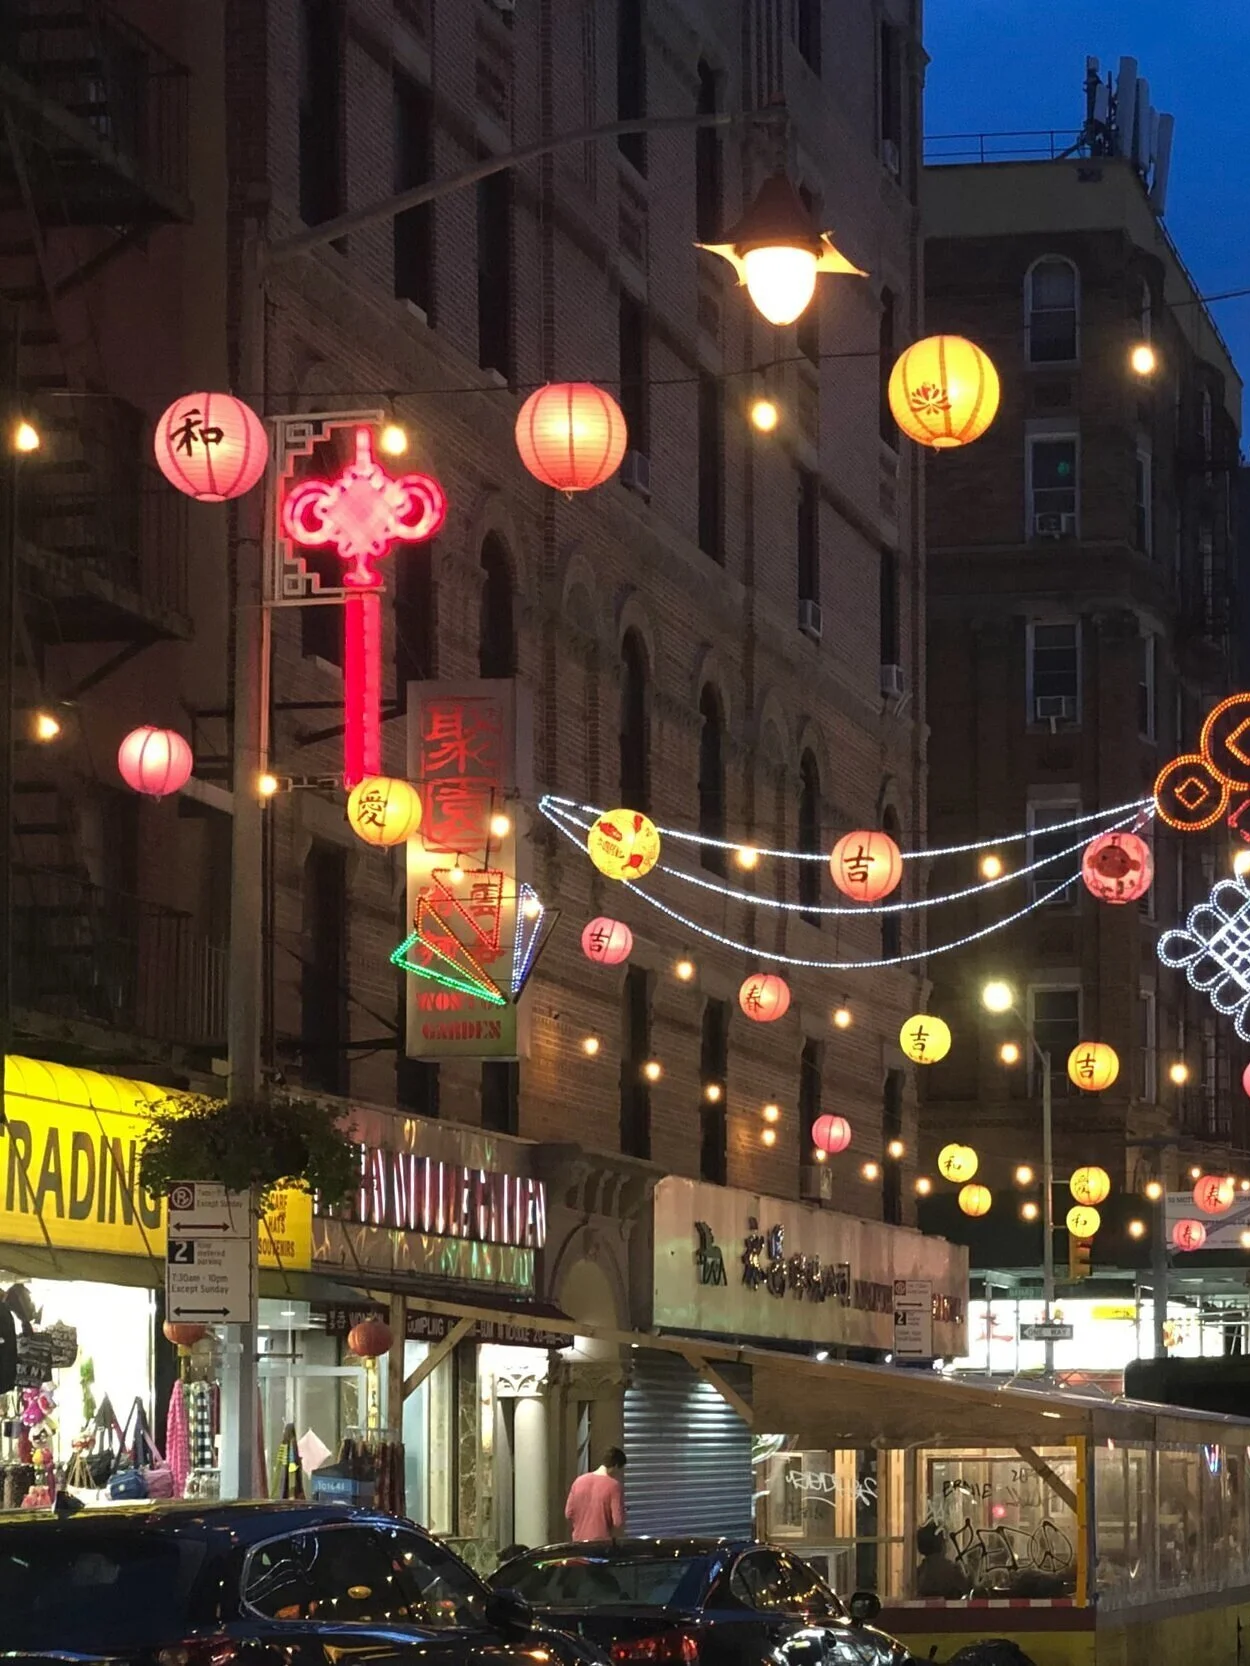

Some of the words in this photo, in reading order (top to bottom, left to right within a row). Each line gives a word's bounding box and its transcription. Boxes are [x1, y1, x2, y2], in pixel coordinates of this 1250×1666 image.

[169, 407, 224, 458] 和
[357, 789, 386, 828] 愛
[844, 845, 874, 882] 吉
[590, 927, 611, 953] 吉
[910, 1025, 929, 1052] 吉
[1077, 1052, 1097, 1079] 吉
[0, 1118, 162, 1230] RADING
[174, 1241, 189, 1262] 2
[172, 1284, 199, 1295] Except
[200, 1284, 230, 1295] Sunday
